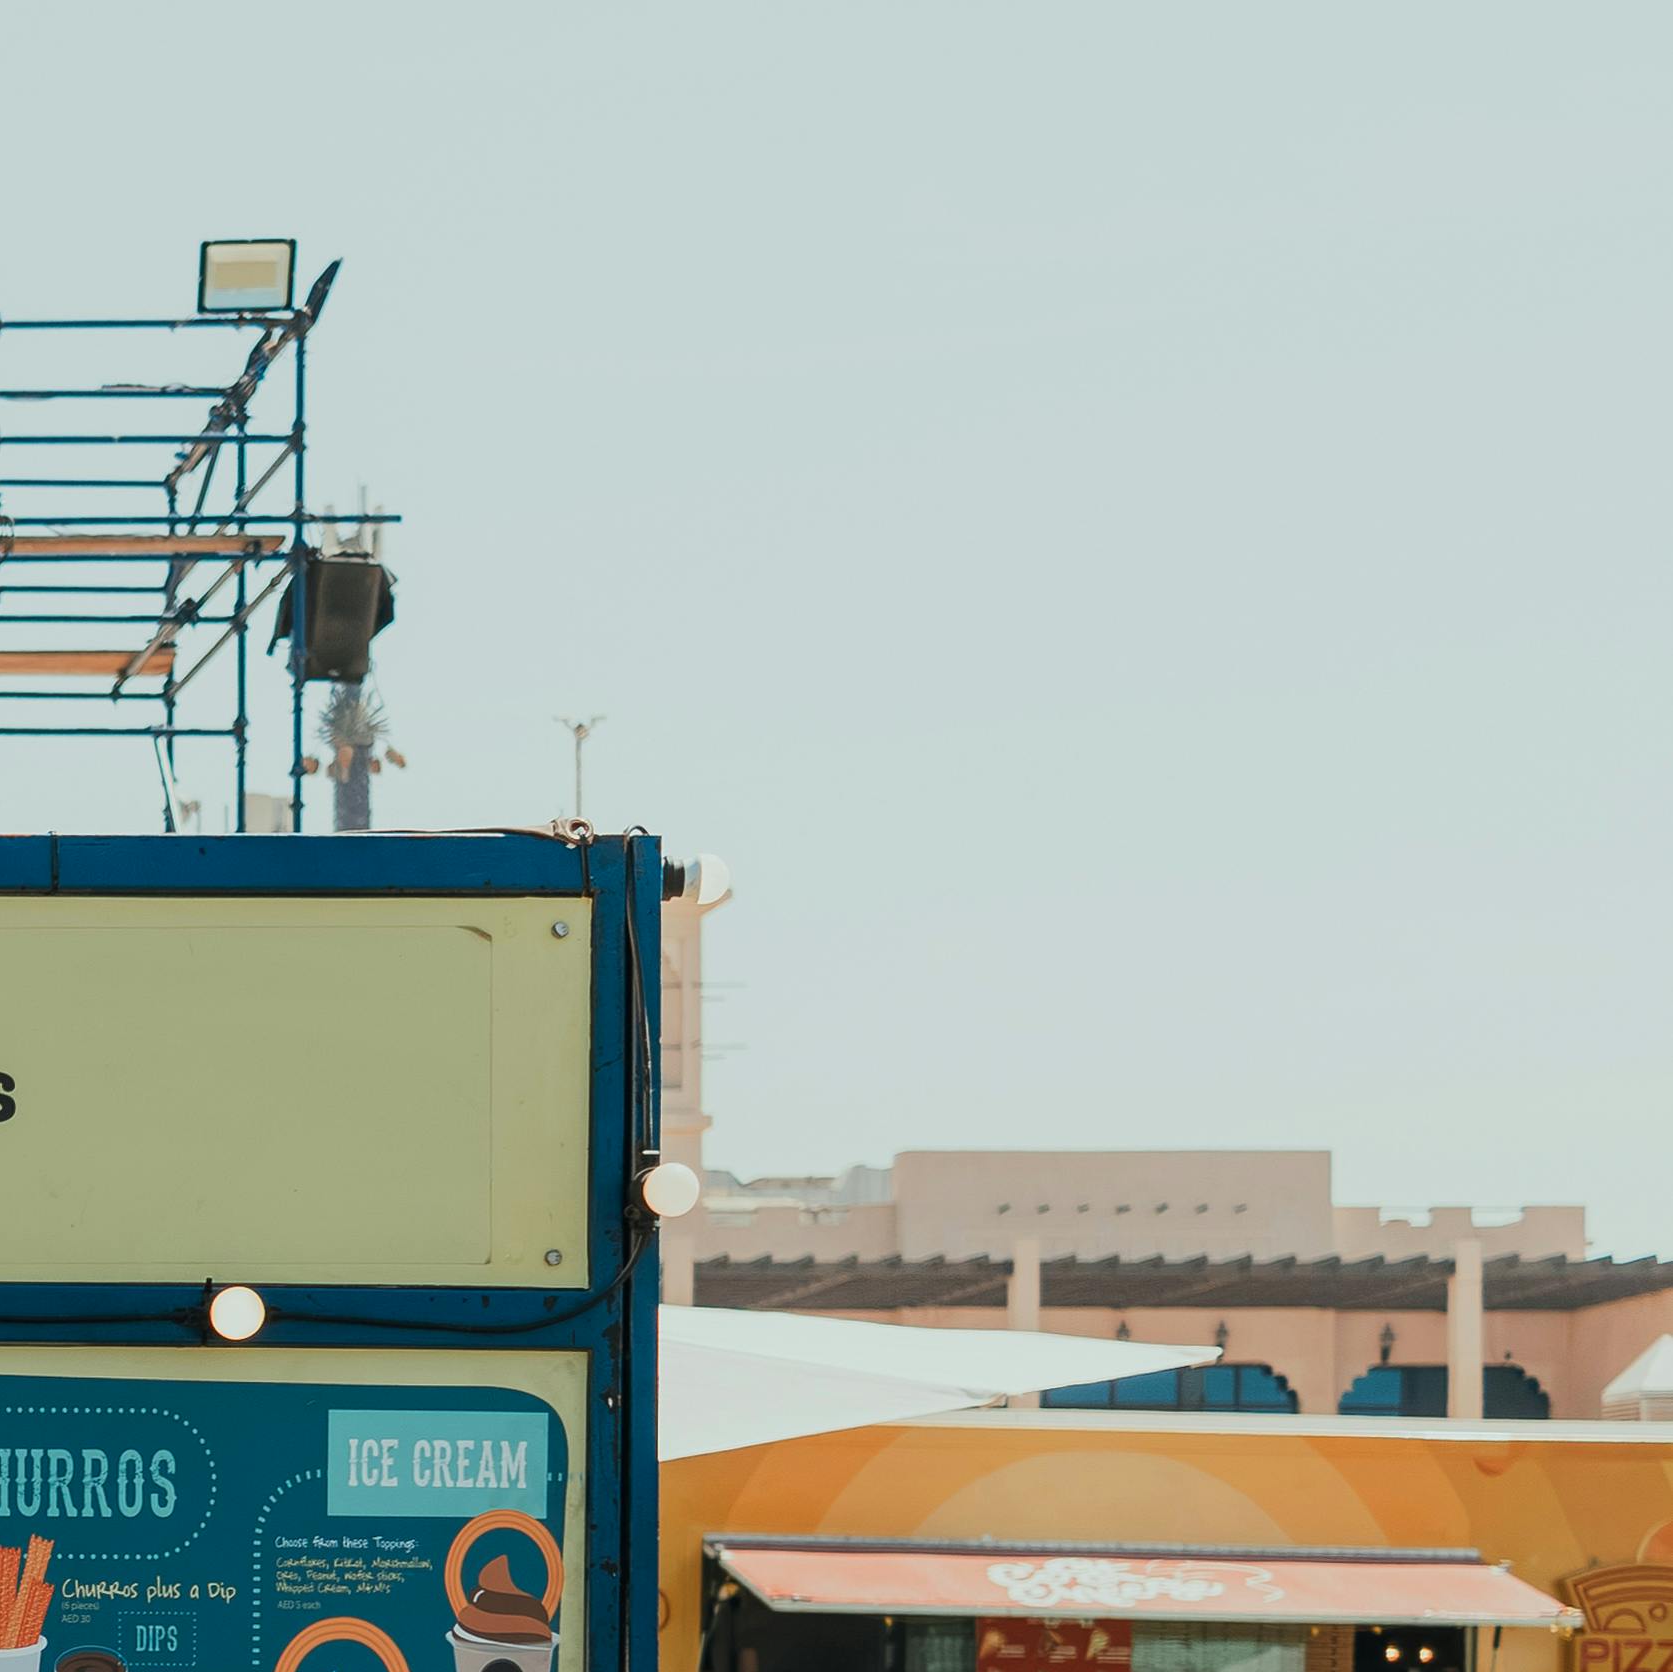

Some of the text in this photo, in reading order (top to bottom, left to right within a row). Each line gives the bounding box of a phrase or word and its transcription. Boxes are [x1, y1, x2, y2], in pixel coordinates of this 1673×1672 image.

[349, 1439, 527, 1488] ICE CREAM
[275, 1537, 308, 1548] Choose
[343, 1536, 368, 1548] these
[62, 1576, 236, 1603] Churros plus a Dip
[136, 1626, 177, 1651] DIPS
